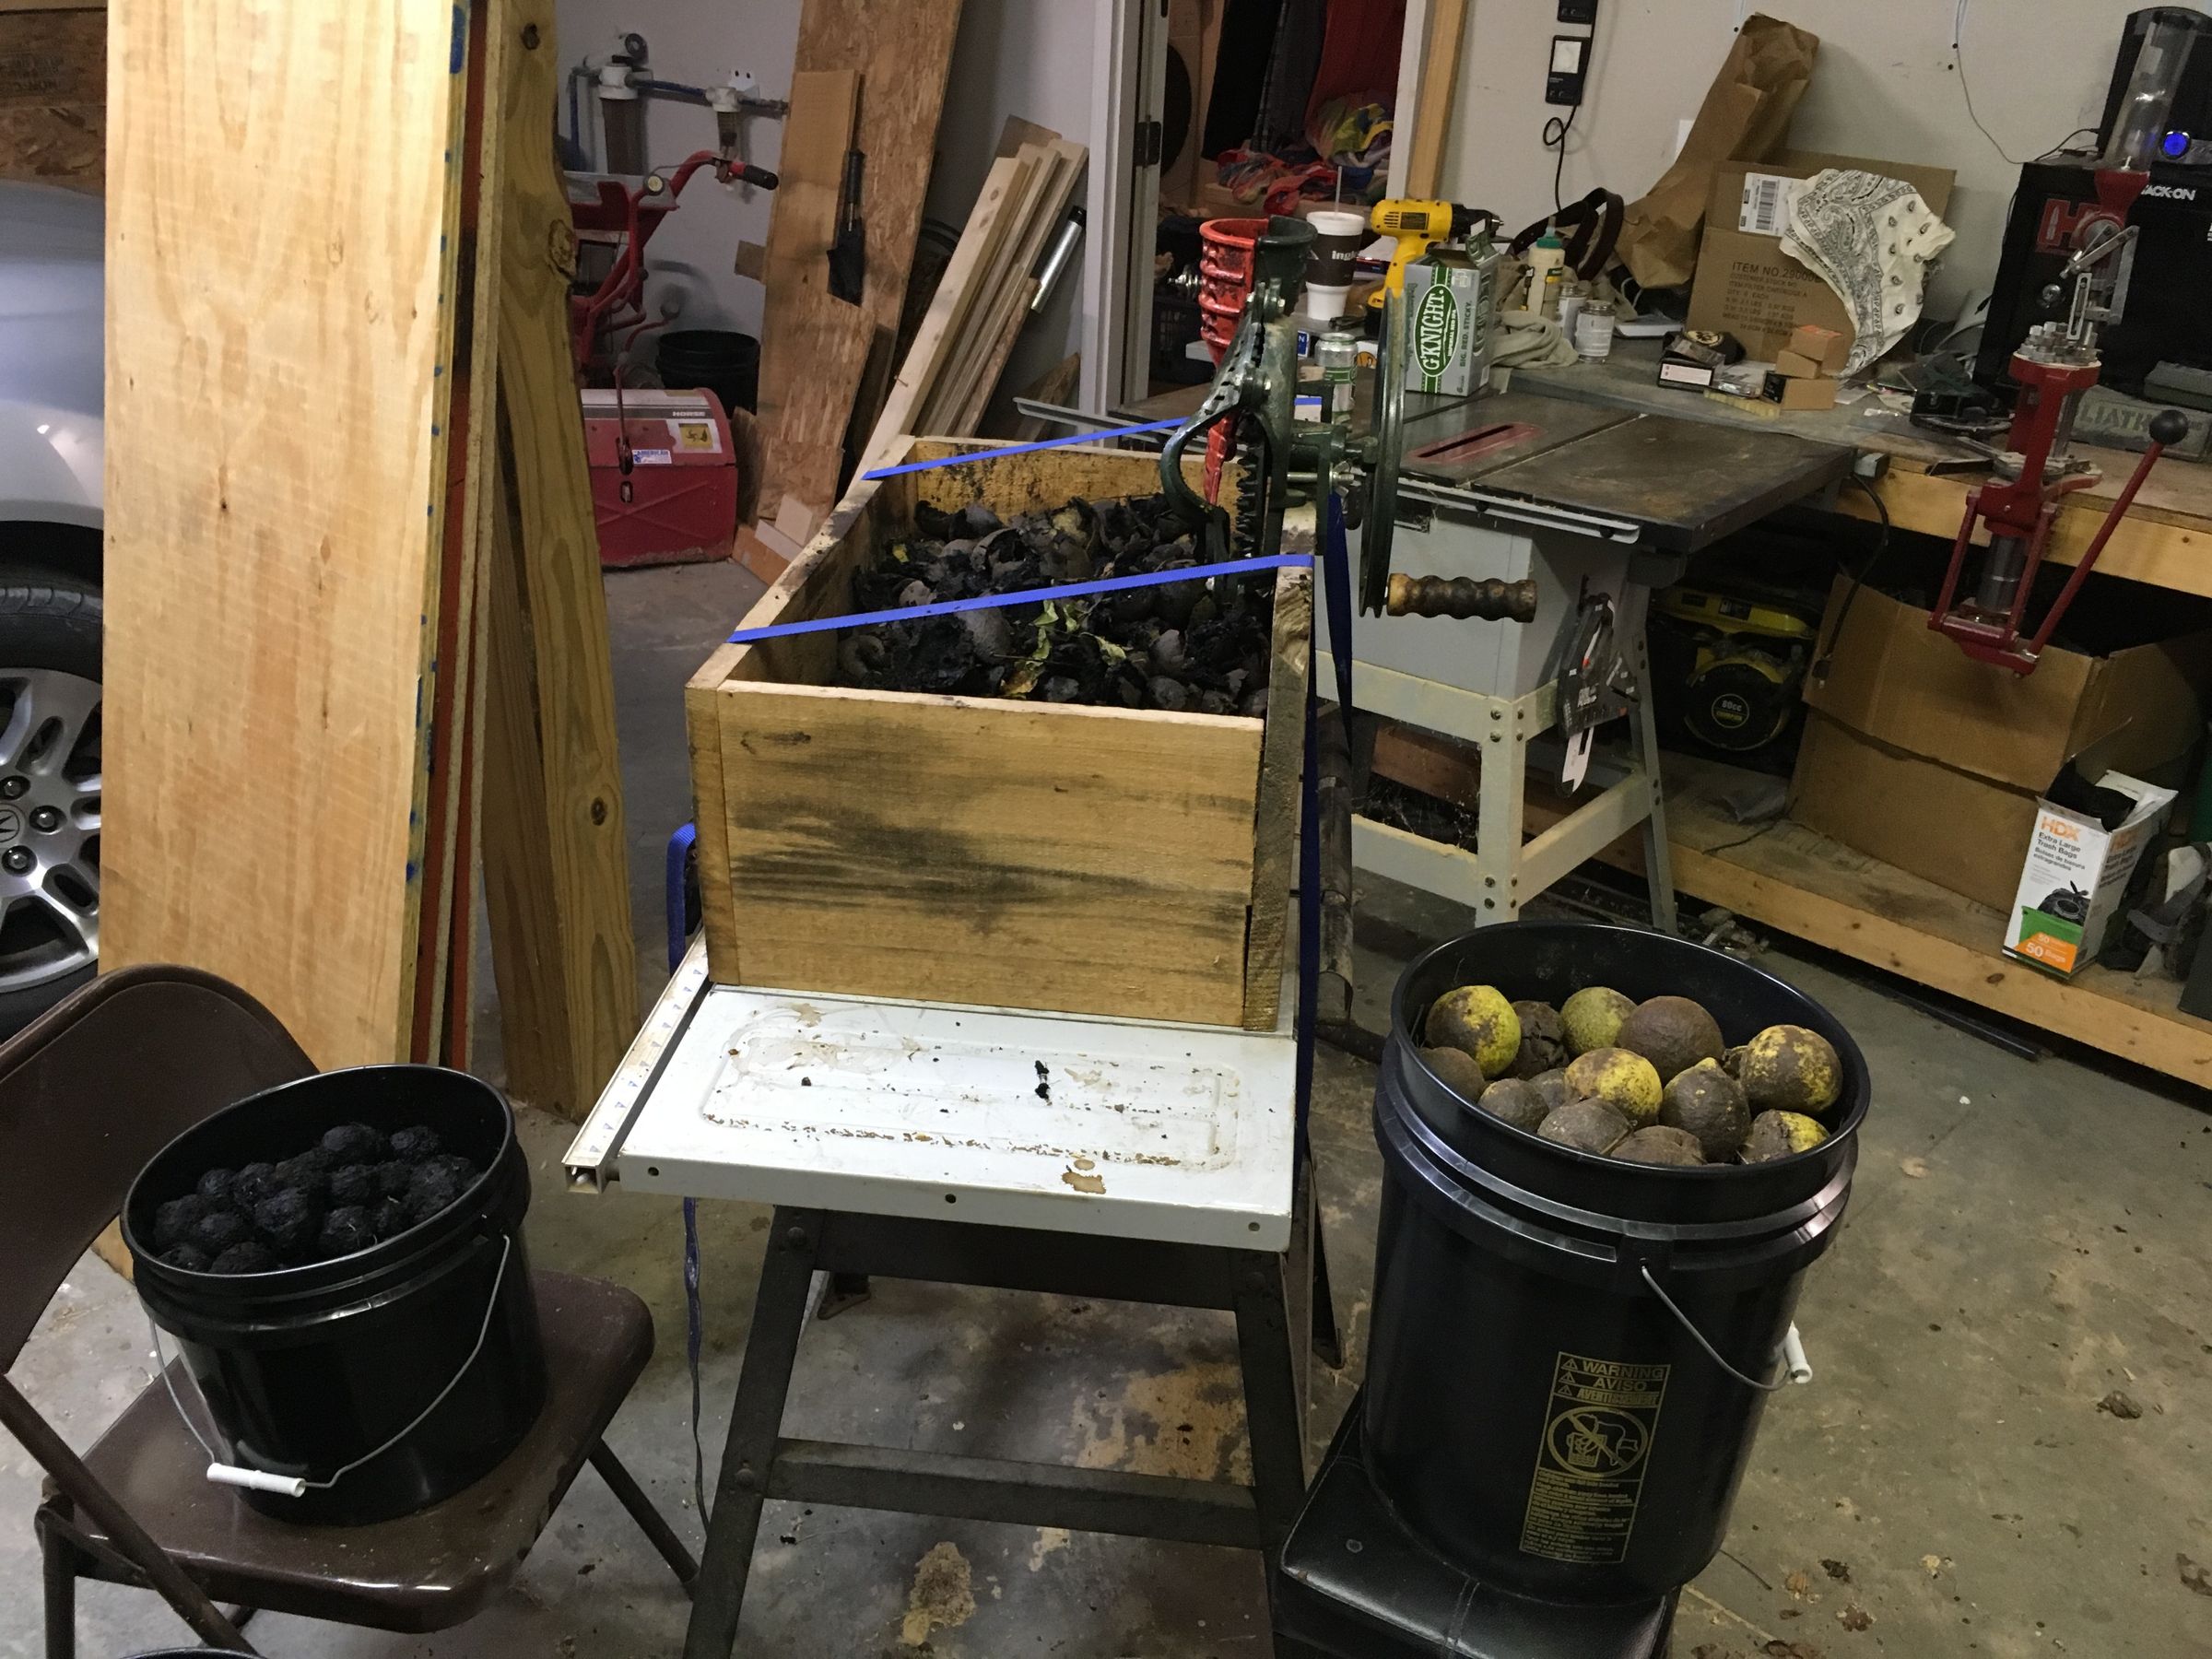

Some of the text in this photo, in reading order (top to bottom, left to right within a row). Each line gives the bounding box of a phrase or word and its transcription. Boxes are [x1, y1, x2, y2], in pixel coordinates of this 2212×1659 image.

[1732, 262, 1759, 274] ITEM
[2041, 817, 2081, 841] HDX
[2037, 839, 2077, 859] Trash Bags
[2039, 832, 2081, 853] Extra Large
[2026, 942, 2043, 958] 50
[1583, 1359, 1665, 1379] WARNING
[1593, 1377, 1648, 1392] AVISO
